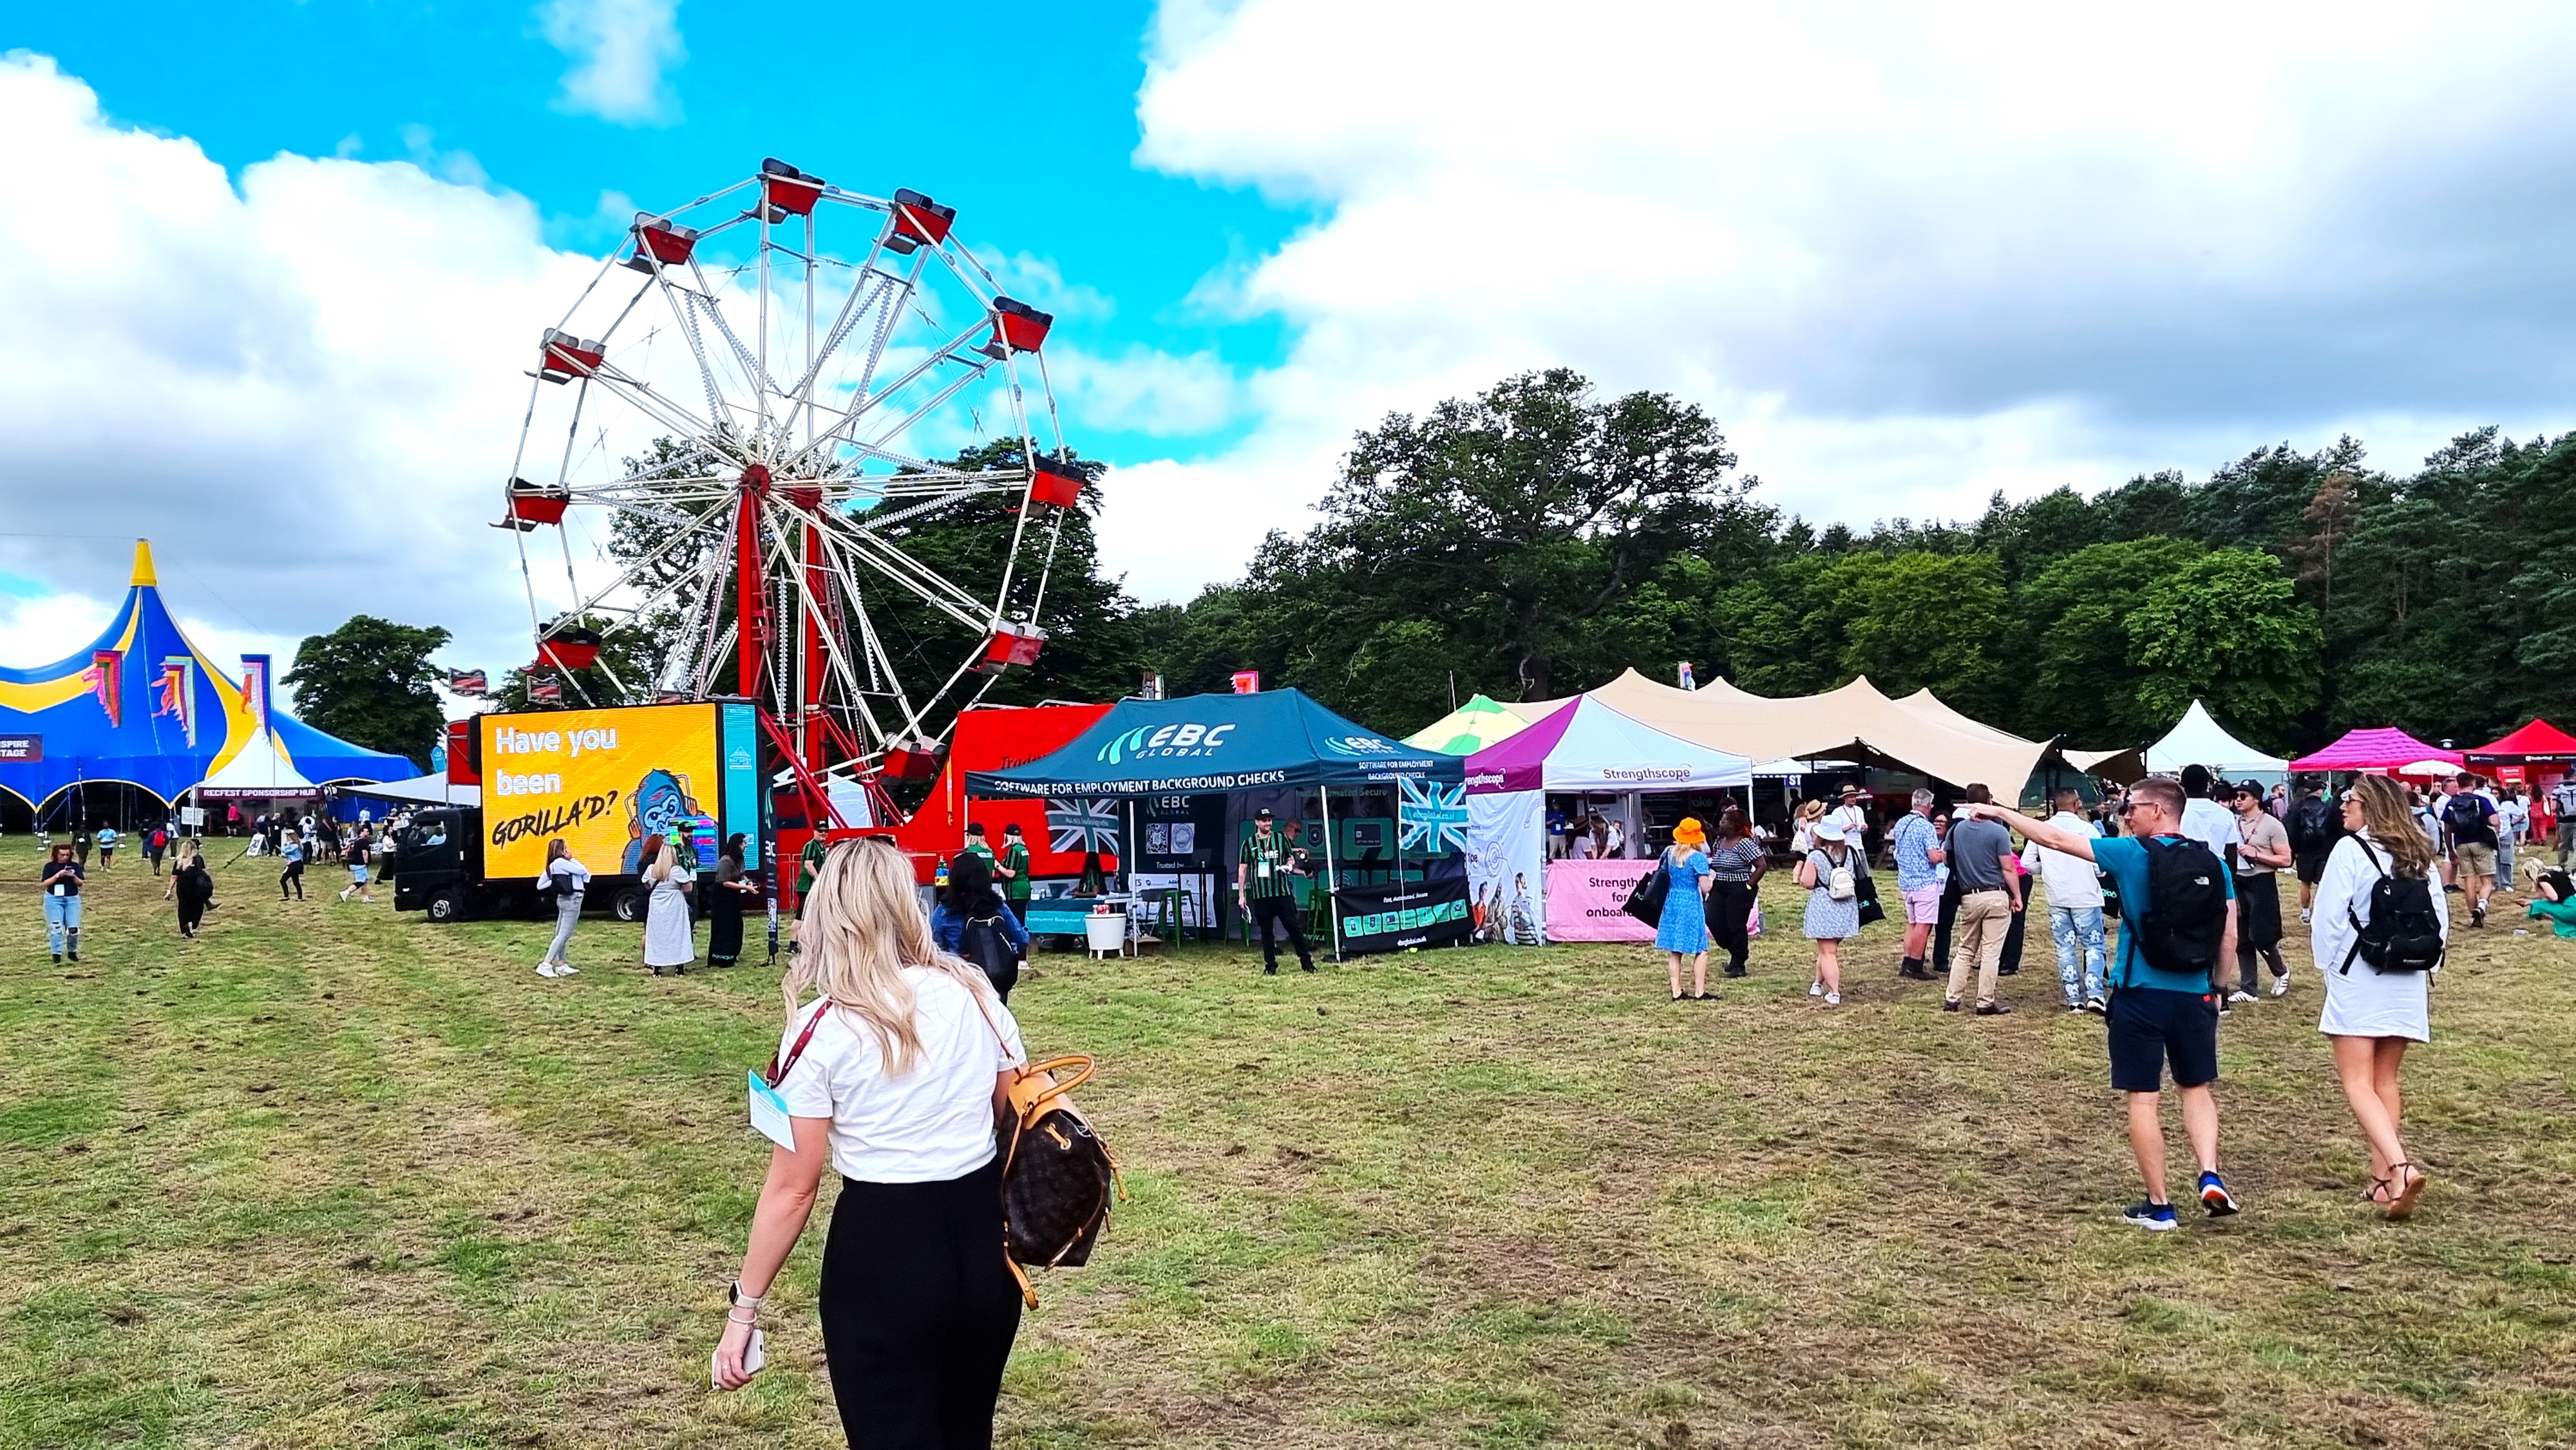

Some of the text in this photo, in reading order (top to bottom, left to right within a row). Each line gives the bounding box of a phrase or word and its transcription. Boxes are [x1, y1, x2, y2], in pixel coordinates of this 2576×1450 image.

[496, 727, 617, 758] Have you
[1148, 724, 1236, 748] EBC
[1344, 737, 1394, 750] EBC
[0, 749, 27, 757] TAGE
[1135, 747, 1213, 759] GLOBAL
[1358, 761, 1387, 769] SOFTWARE
[1464, 772, 1504, 787] rengthscope
[1603, 767, 1691, 781] Strengthscope
[496, 769, 561, 796] been
[994, 770, 1285, 795] SOFTWARE FOR EMPLOYMENT BACKGROUND CHECKS
[1161, 795, 1190, 808] EBC
[492, 789, 618, 850] GORILLA'D?
[1589, 877, 1639, 890] Strength
[1612, 892, 1628, 902] for
[1586, 907, 1634, 917] onboar
